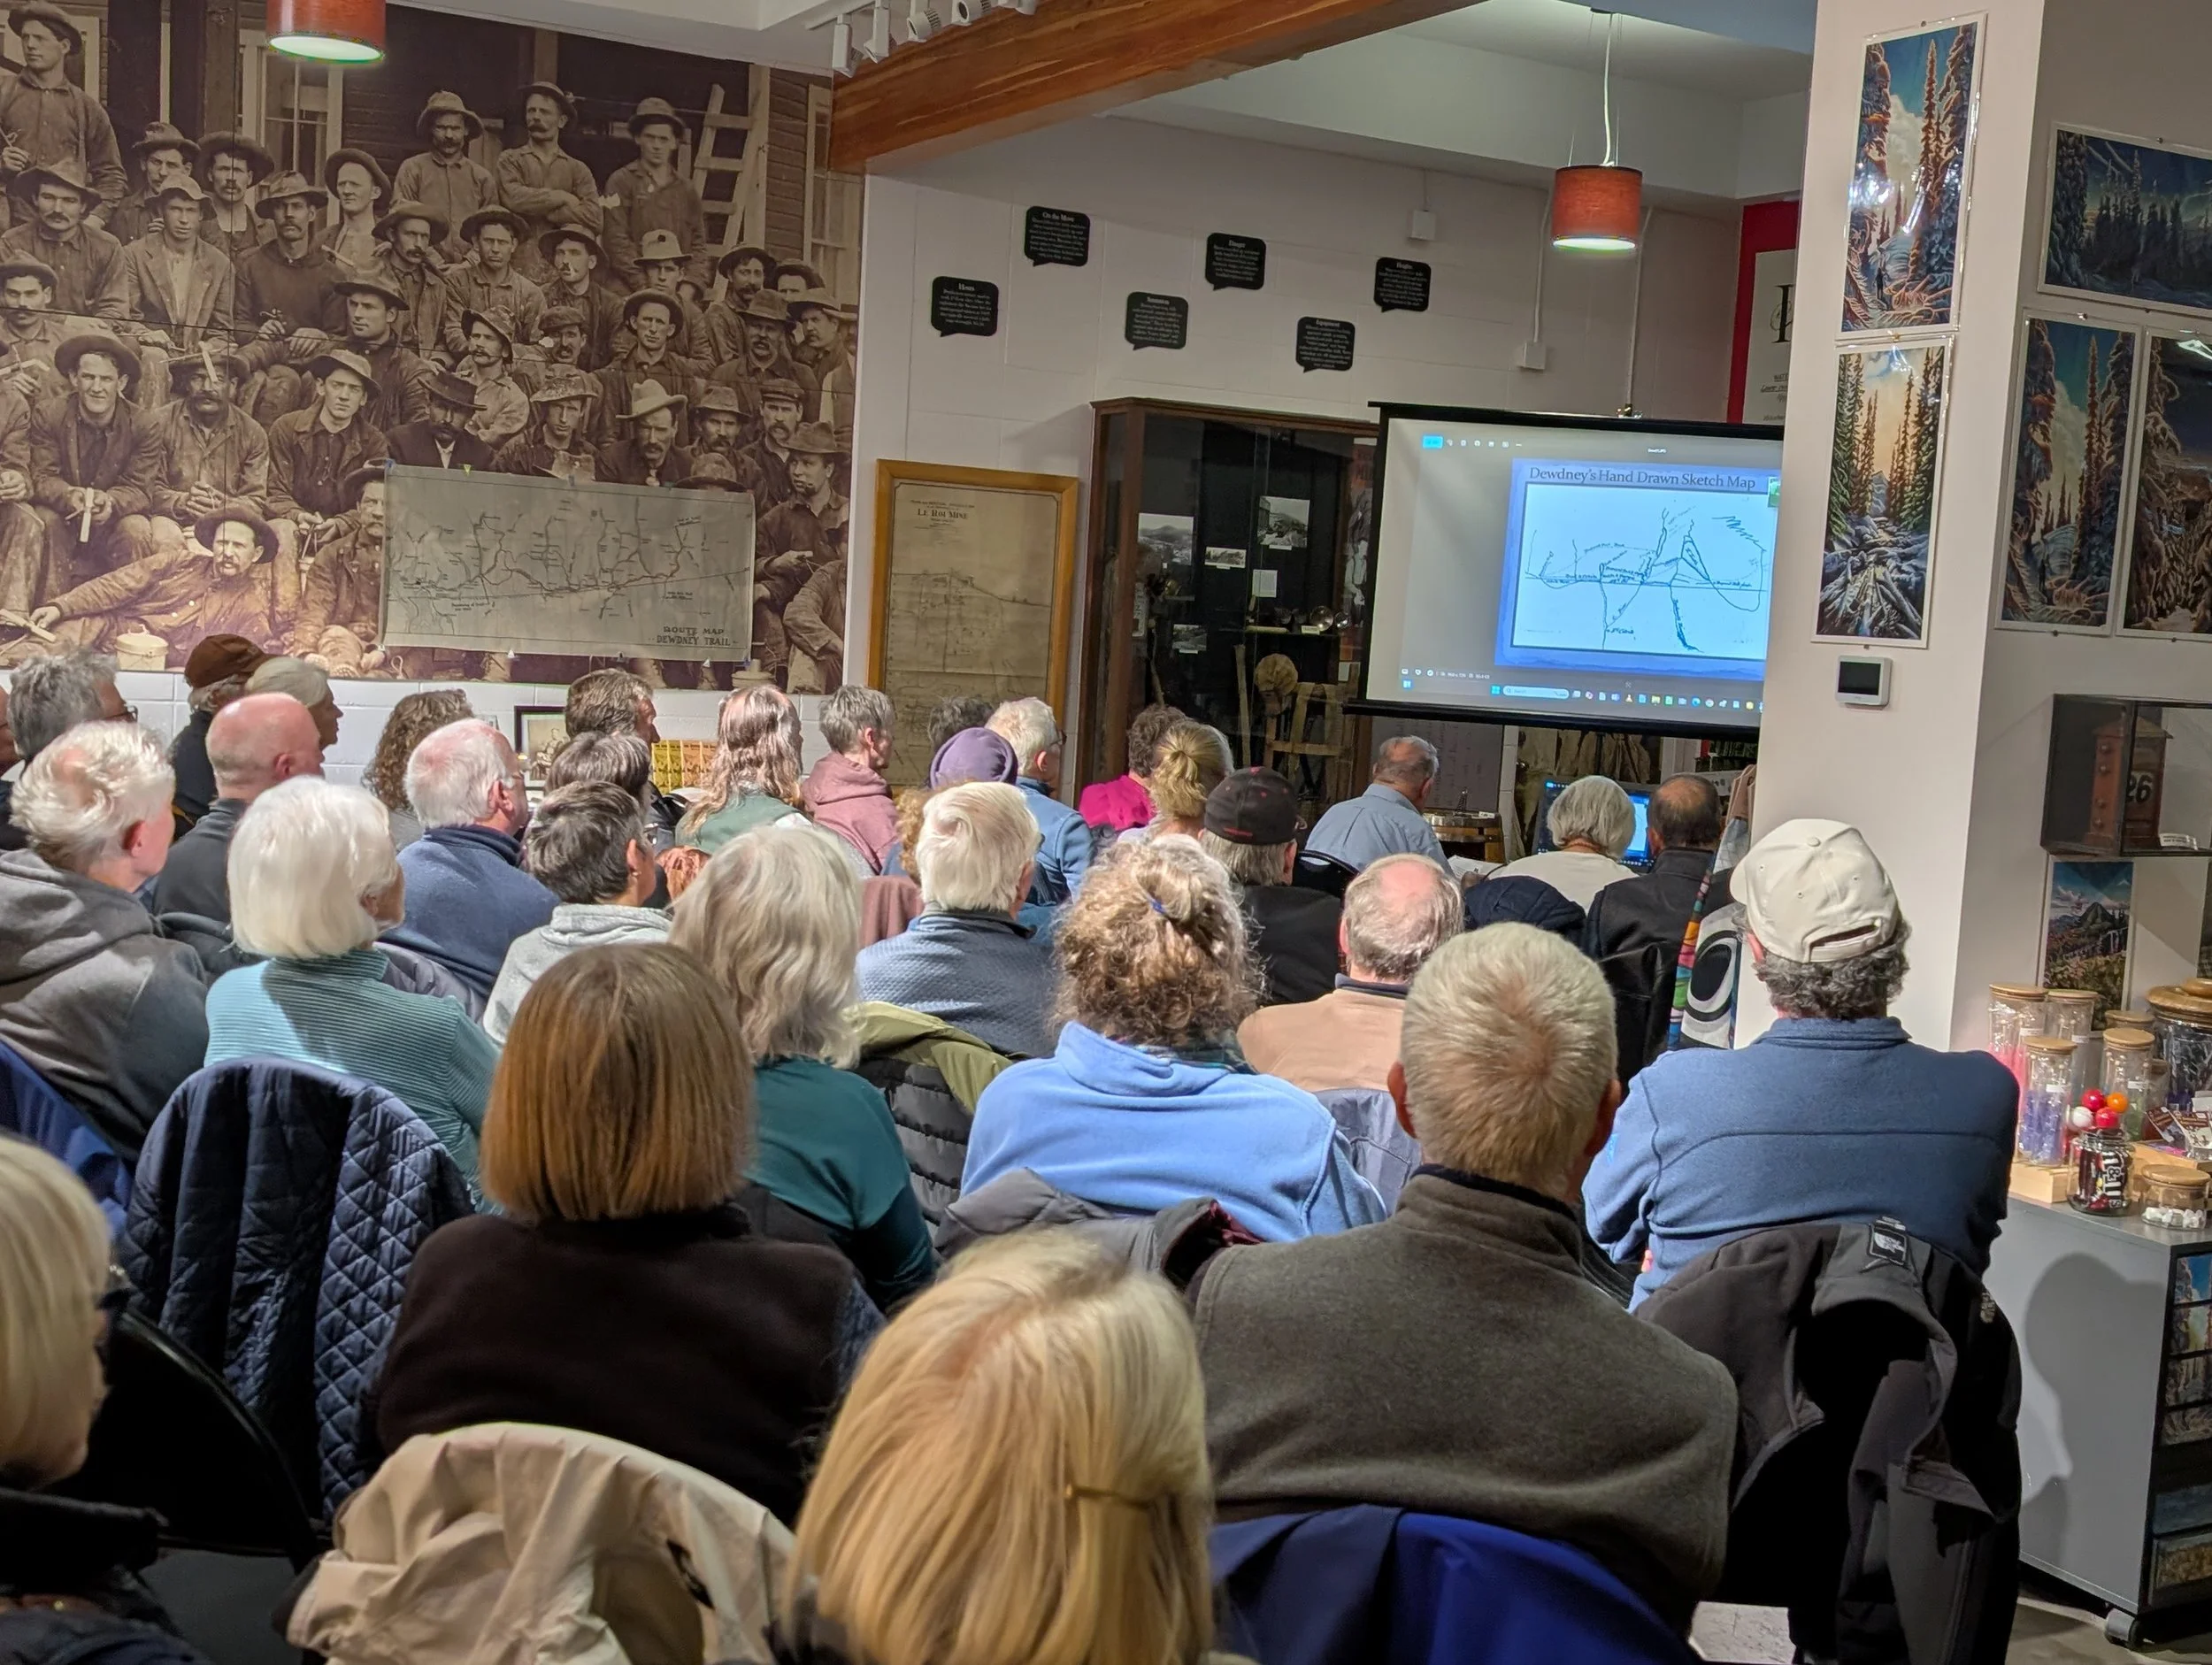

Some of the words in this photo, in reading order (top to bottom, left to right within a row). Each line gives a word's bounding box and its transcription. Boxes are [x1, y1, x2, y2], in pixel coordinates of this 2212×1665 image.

[1529, 466, 1596, 484] Dewdney's
[1599, 470, 1633, 484] Hand
[1637, 472, 1679, 486] Drawn
[1681, 473, 1724, 488] Sketch
[1727, 476, 1756, 491] Map
[657, 634, 699, 646] DEWDNEY
[704, 636, 731, 647] TRAIL
